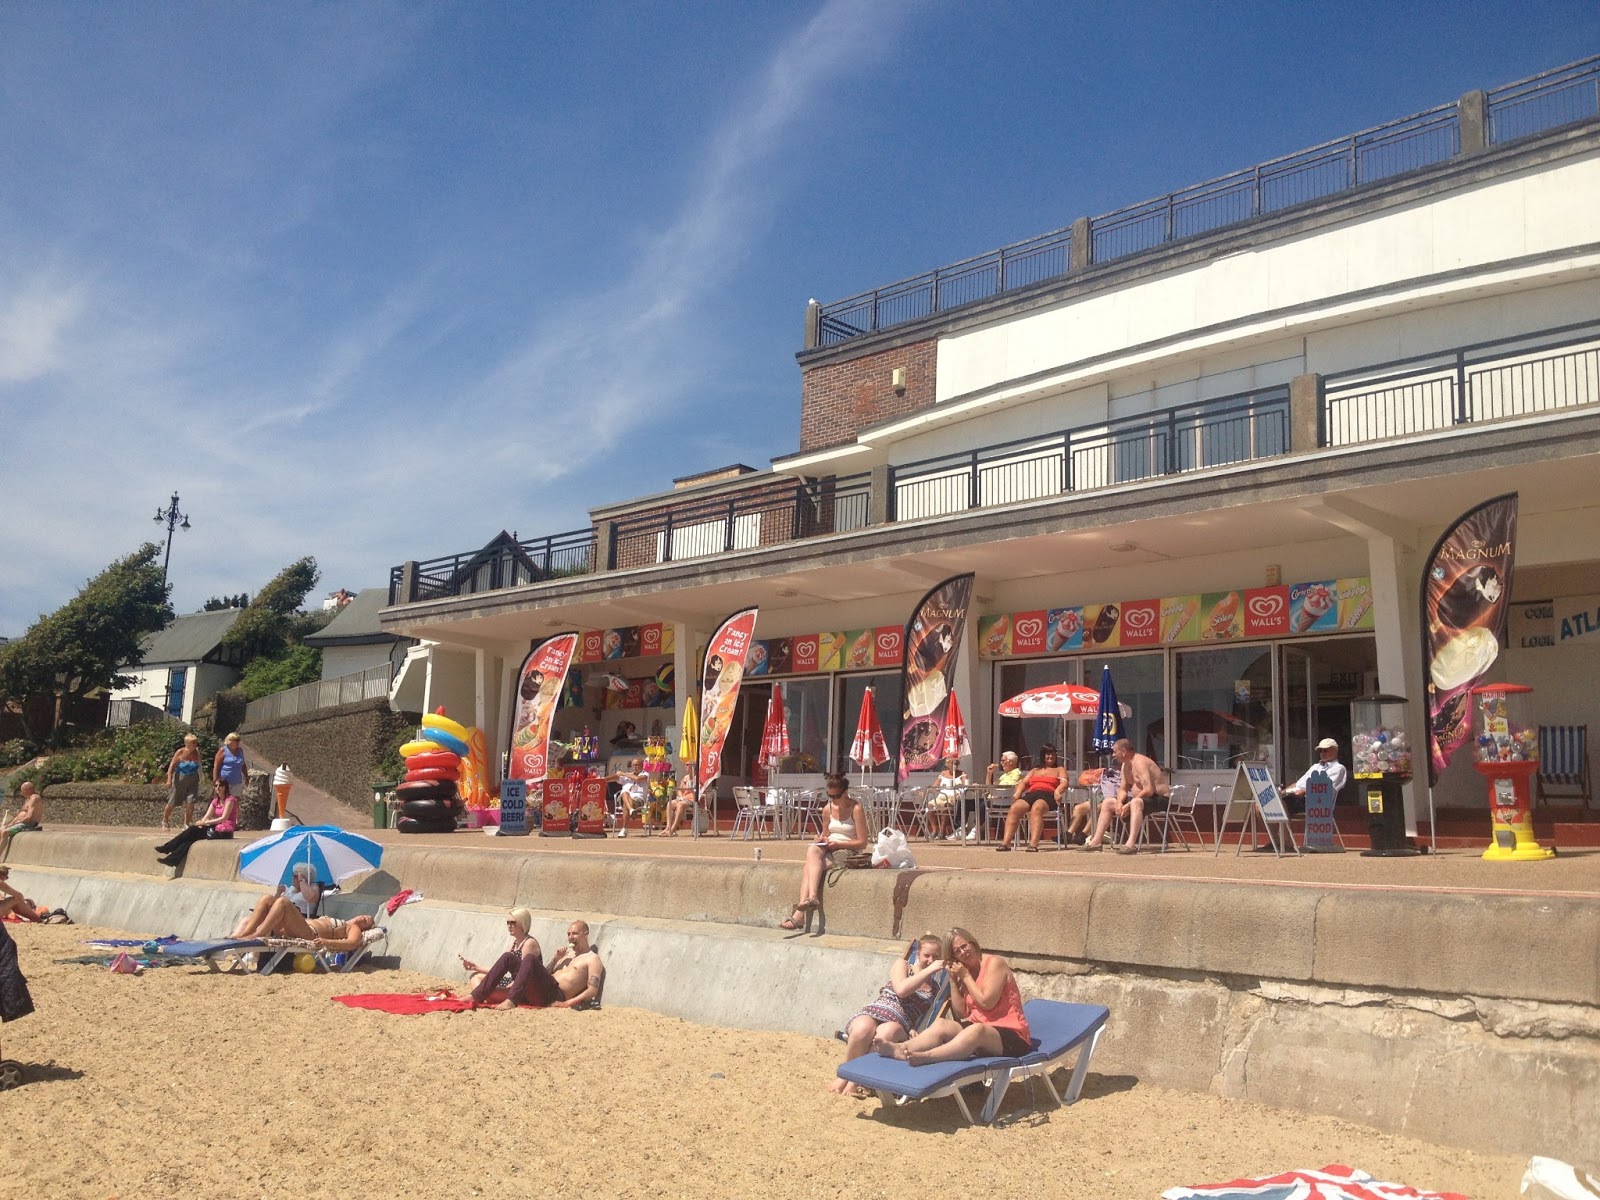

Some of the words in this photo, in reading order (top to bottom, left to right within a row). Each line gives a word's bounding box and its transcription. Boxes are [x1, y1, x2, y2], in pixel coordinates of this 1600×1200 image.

[1440, 541, 1512, 560] MAGNUM
[920, 608, 966, 619] MAGNUM
[1250, 616, 1282, 627] WALL'S
[1561, 606, 1600, 640] ATL
[726, 627, 749, 642] Fancy
[1126, 629, 1153, 638] WALL'S
[1017, 636, 1042, 646] WALL'S
[1521, 635, 1555, 648] LOOK
[547, 646, 568, 660] Fancy
[878, 650, 900, 658] WALL'S
[796, 656, 816, 665] WALL'S
[1330, 672, 1358, 683] EXIT
[1482, 691, 1505, 699] HARIBO
[507, 787, 520, 797] ICE
[1311, 783, 1328, 793] HOT
[502, 800, 524, 810] COLD
[501, 812, 525, 822] BEERS
[1308, 807, 1331, 818] COLD
[1308, 823, 1332, 834] FOOD
